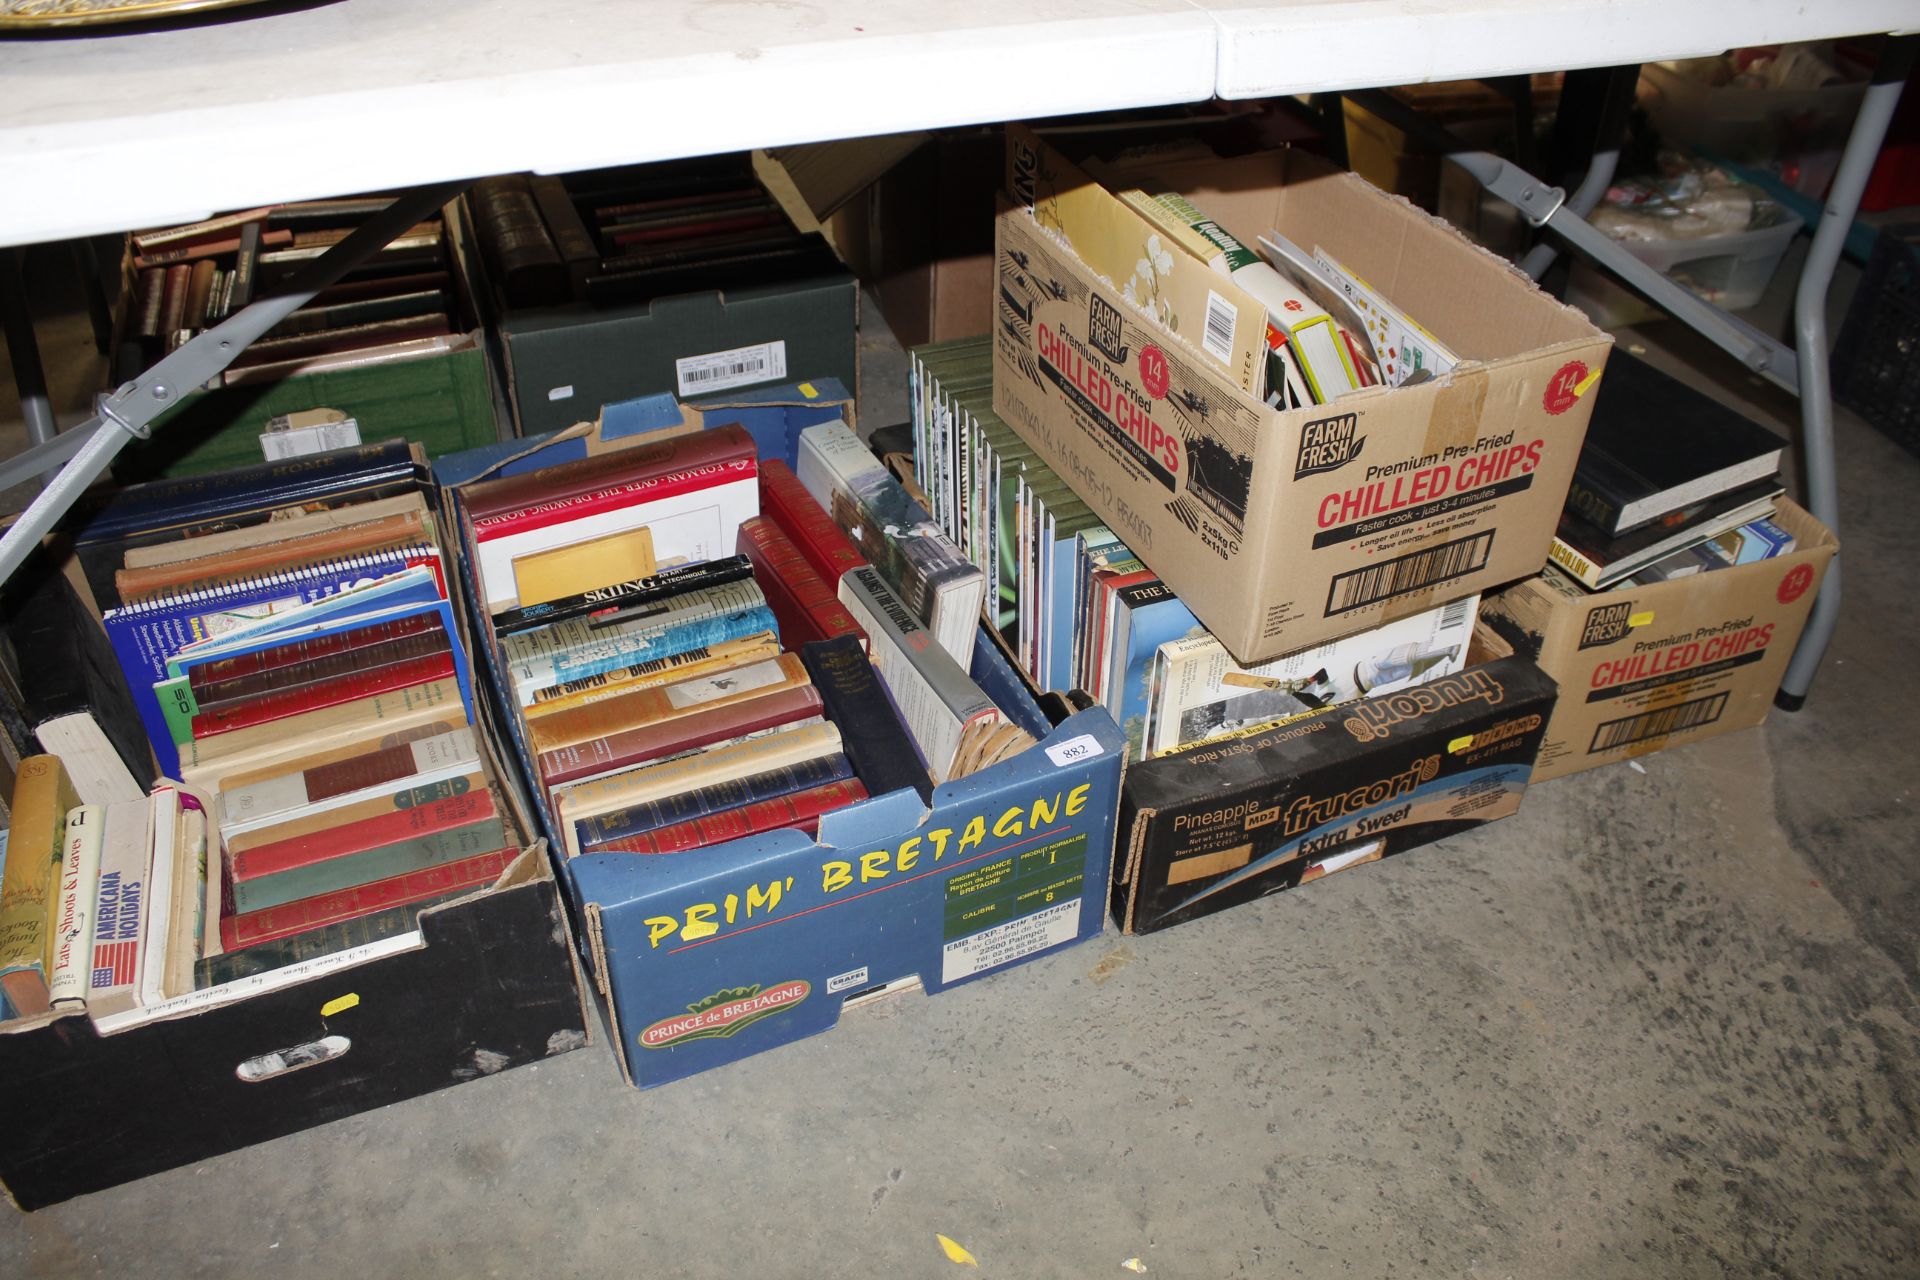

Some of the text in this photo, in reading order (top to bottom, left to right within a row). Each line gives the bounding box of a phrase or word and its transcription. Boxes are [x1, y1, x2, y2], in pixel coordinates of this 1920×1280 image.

[1199, 222, 1242, 251] Healthy
[1092, 298, 1121, 330] FARM
[1090, 318, 1120, 357] FRESH
[1060, 323, 1100, 370] Premium
[1103, 362, 1151, 414] Pre-Fried
[1148, 355, 1162, 382] 14
[1557, 372, 1576, 394] 14
[1038, 323, 1179, 472] CHILLED CHIPS
[1303, 416, 1352, 447] FARM
[1121, 432, 1148, 465] minutes
[1299, 440, 1349, 470] FRESH
[1365, 430, 1514, 482] Premium Pre-Fried
[598, 486, 622, 500] THE
[627, 479, 659, 494] OVER
[1317, 439, 1545, 528] CHILLED CHIPS
[481, 509, 526, 528] BOARD
[530, 493, 593, 517] DRAWING
[1355, 487, 1496, 534] Faster cook just 3-4 minutes
[1202, 521, 1228, 548] 2x5kg
[1359, 504, 1497, 548] Longer oil life Less oil absorption
[1376, 518, 1477, 551] Save save money
[1201, 533, 1229, 560] 2x11lb
[584, 577, 656, 604] SKIING
[658, 571, 670, 580] AN
[666, 569, 708, 584] TECHNIQUE
[854, 568, 920, 635] AGAINST THE EVIDENCE
[1130, 586, 1163, 601] THE
[1589, 606, 1629, 627] FARM
[151, 621, 165, 648] Needham
[1583, 623, 1624, 643] FRESH
[1633, 616, 1753, 653] Premium Pre-Fried
[559, 637, 652, 669] SAVAGE SEA
[1590, 643, 1700, 688] CHILLED
[1702, 623, 1776, 662] CHIPS
[541, 648, 712, 700] THE SNIPER BARRY WYNNE
[1355, 669, 1504, 737] frucori
[1062, 744, 1088, 759] 882
[1189, 721, 1326, 765] PRODUCT OF COSTA RICA
[1284, 758, 1424, 837] frucori
[1174, 799, 1260, 832] Pineapple
[1249, 811, 1276, 825] MD2
[1298, 804, 1412, 857] Extra Sweet
[822, 783, 1092, 893] BRETAGNE
[1175, 848, 1194, 856] Store
[1189, 838, 1200, 846] Net
[65, 838, 82, 879] Leaves
[981, 858, 1012, 874] FRANCE
[1020, 847, 1048, 860] PRODUIT
[64, 879, 78, 892] &
[950, 880, 973, 892] Rayon
[985, 867, 1011, 881] culture
[959, 877, 1001, 896] BRETAGNE
[1066, 874, 1083, 885] NETTE
[96, 871, 121, 940] AMERICANA
[118, 881, 141, 938] HOLIDAYS
[962, 904, 996, 920] CALIBRE
[1045, 892, 1054, 902] 8
[59, 893, 76, 934] Shoots
[946, 938, 972, 951] EMB.
[1032, 900, 1079, 921] BRETAGNE
[979, 927, 1046, 956] 22500 Paimpol
[984, 929, 1019, 947] Général
[1021, 924, 1031, 933] de
[1035, 914, 1062, 930] Gaulle
[648, 984, 804, 1043] PRINCE de BRETAGNE
